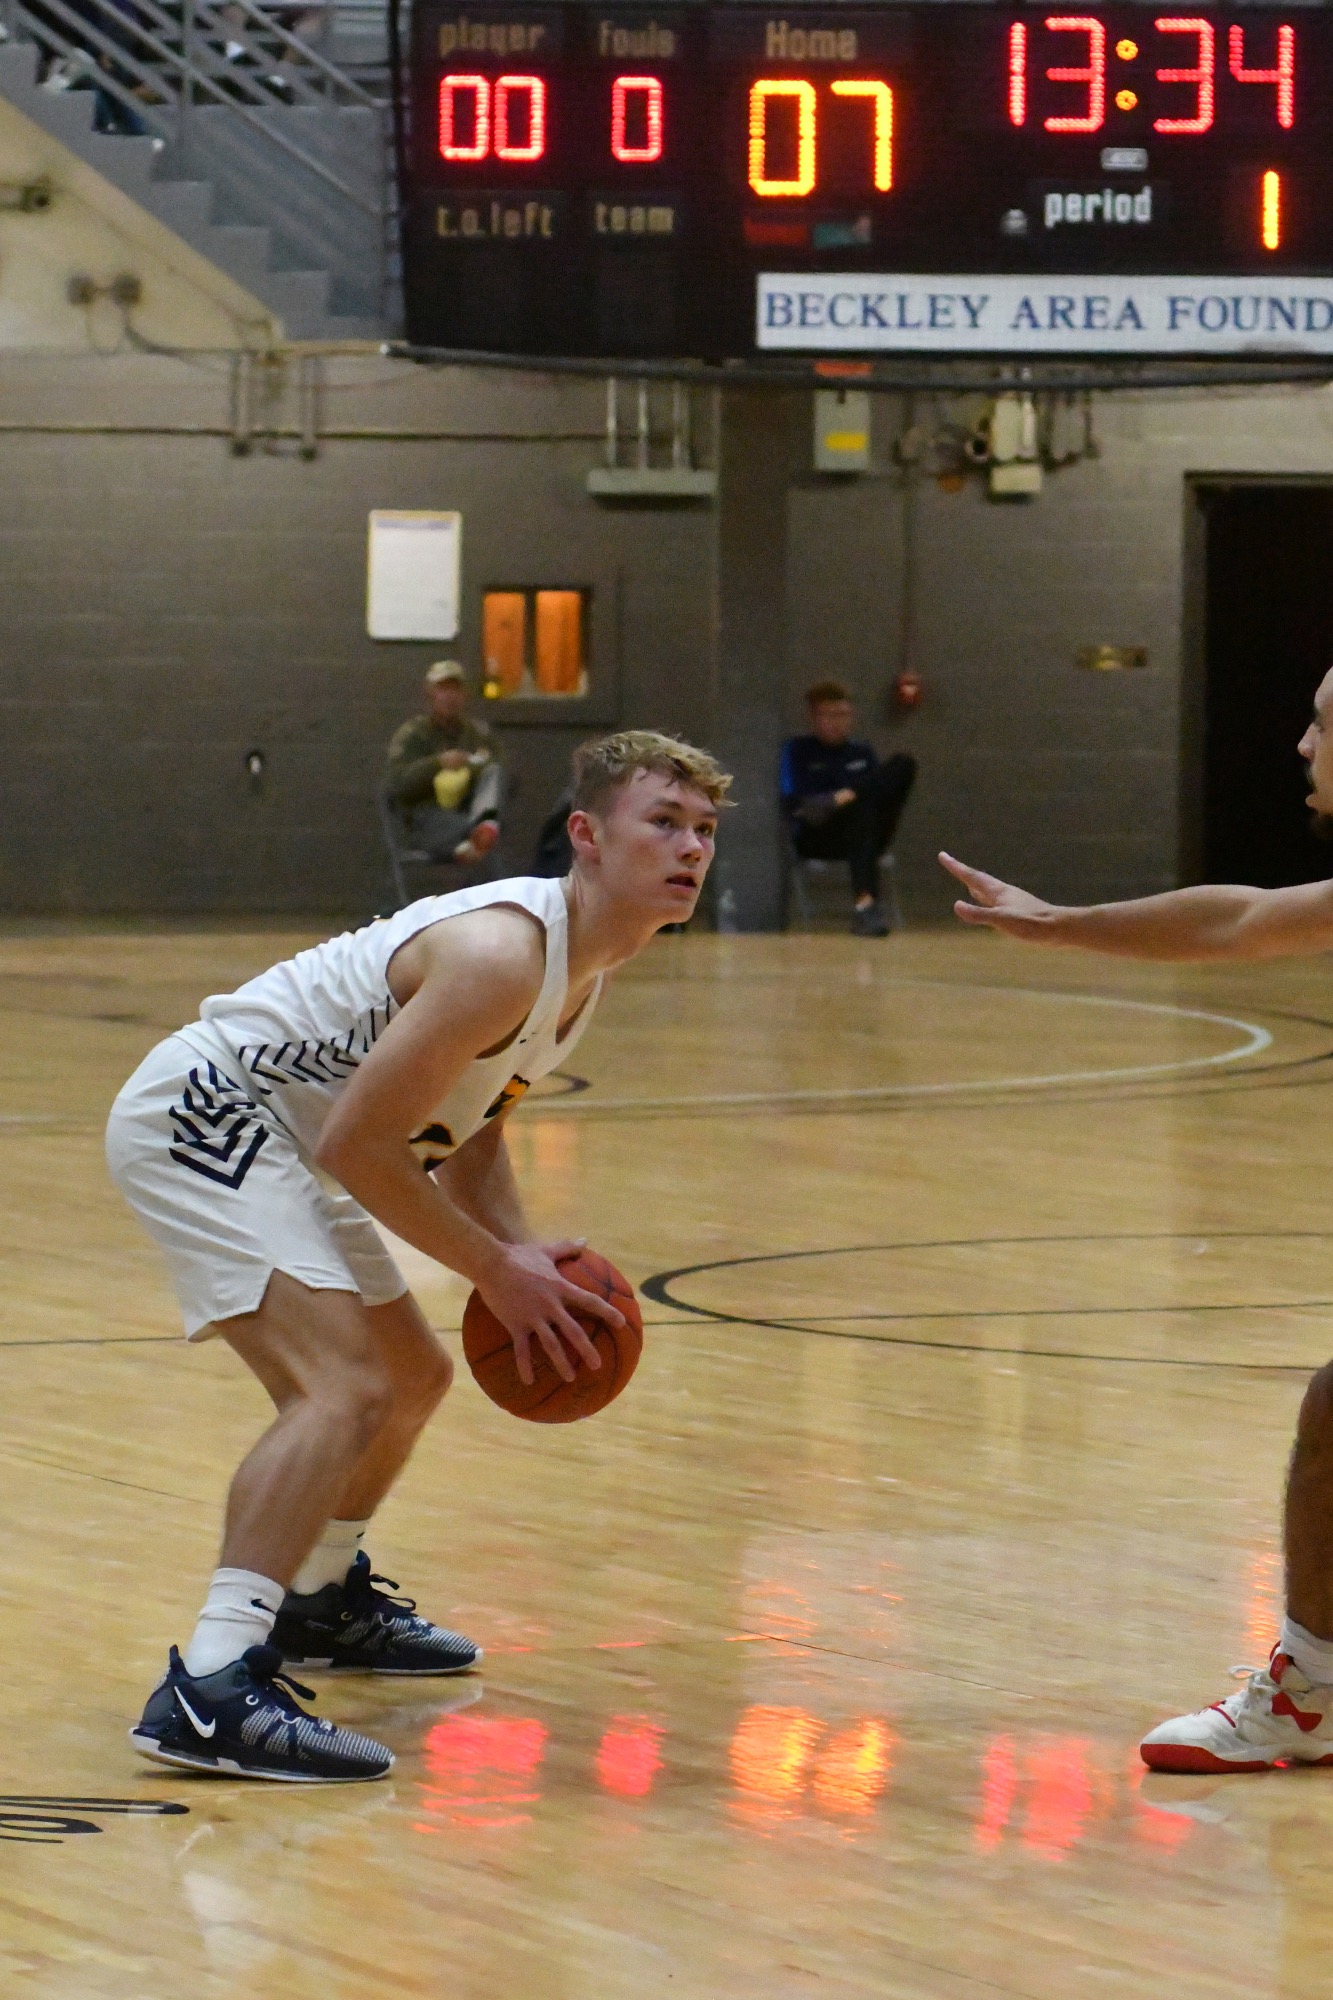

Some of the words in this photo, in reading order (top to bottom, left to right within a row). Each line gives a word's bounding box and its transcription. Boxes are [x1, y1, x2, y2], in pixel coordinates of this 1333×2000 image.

[437, 16, 546, 58] player
[766, 19, 857, 60] Home
[1009, 17, 1295, 133] 13:34
[439, 75, 545, 161] 00
[612, 76, 663, 162] 0
[748, 78, 893, 196] 07
[595, 202, 675, 234] team
[1044, 185, 1152, 228] period
[1262, 170, 1280, 250] 1
[765, 292, 989, 328] BECKLEY
[1009, 294, 1145, 330] AREA
[1167, 295, 1333, 331] FOUND
